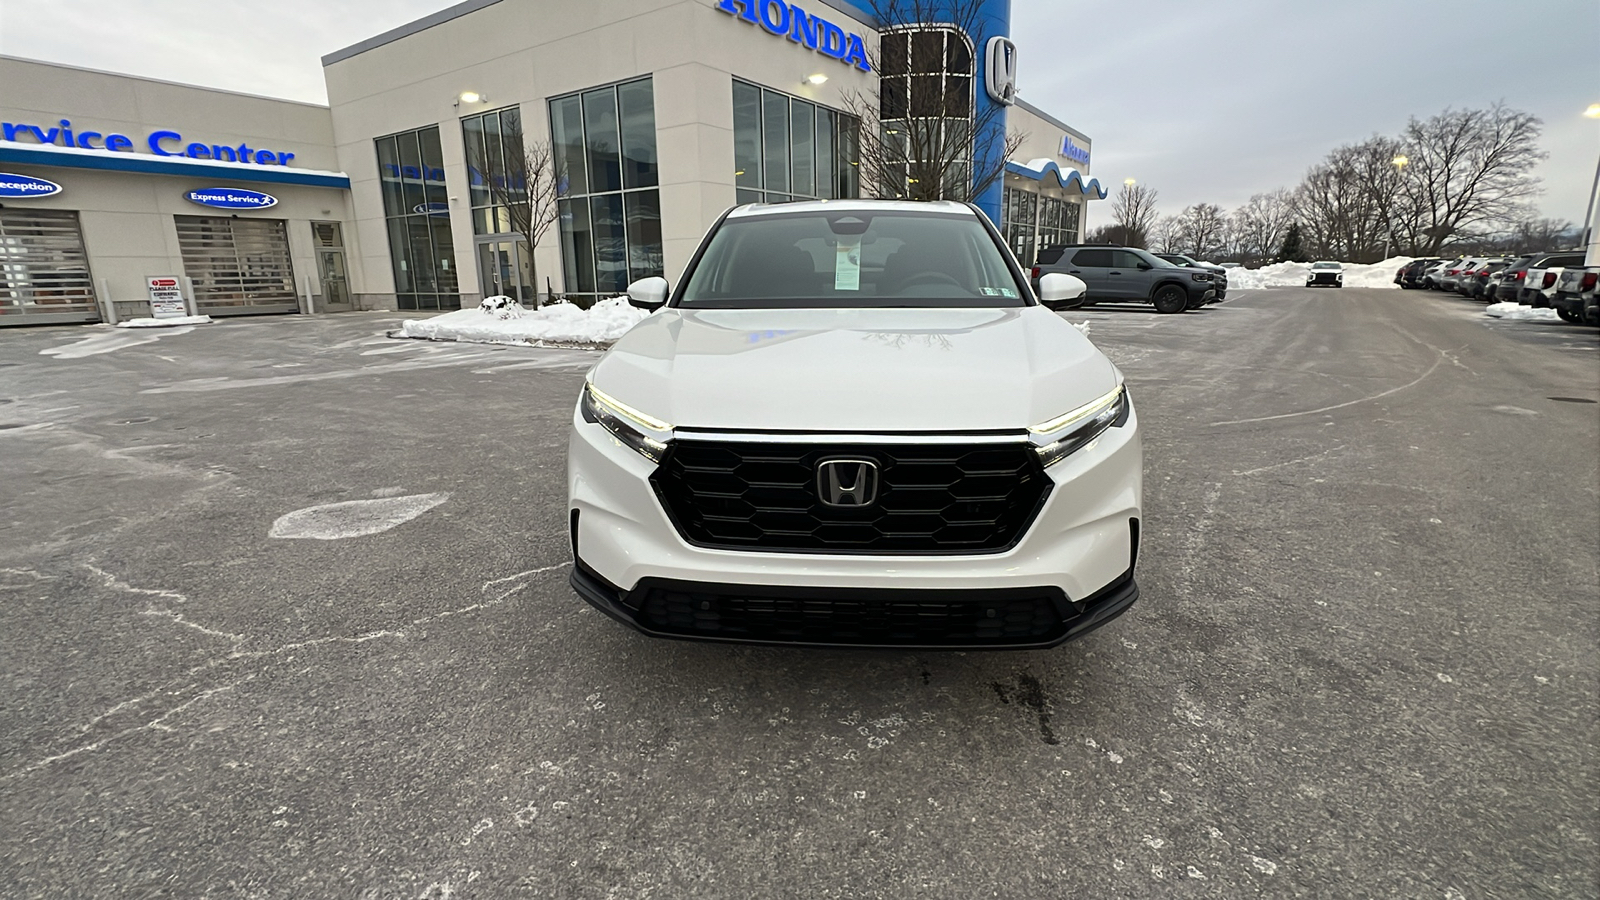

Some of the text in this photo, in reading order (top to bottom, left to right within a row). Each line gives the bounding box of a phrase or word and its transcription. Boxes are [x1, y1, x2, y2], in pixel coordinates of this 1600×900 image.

[715, 0, 871, 72] HONDA
[1, 119, 296, 166] rvice Center
[0, 182, 53, 191] eception
[190, 192, 259, 204] Express Service
